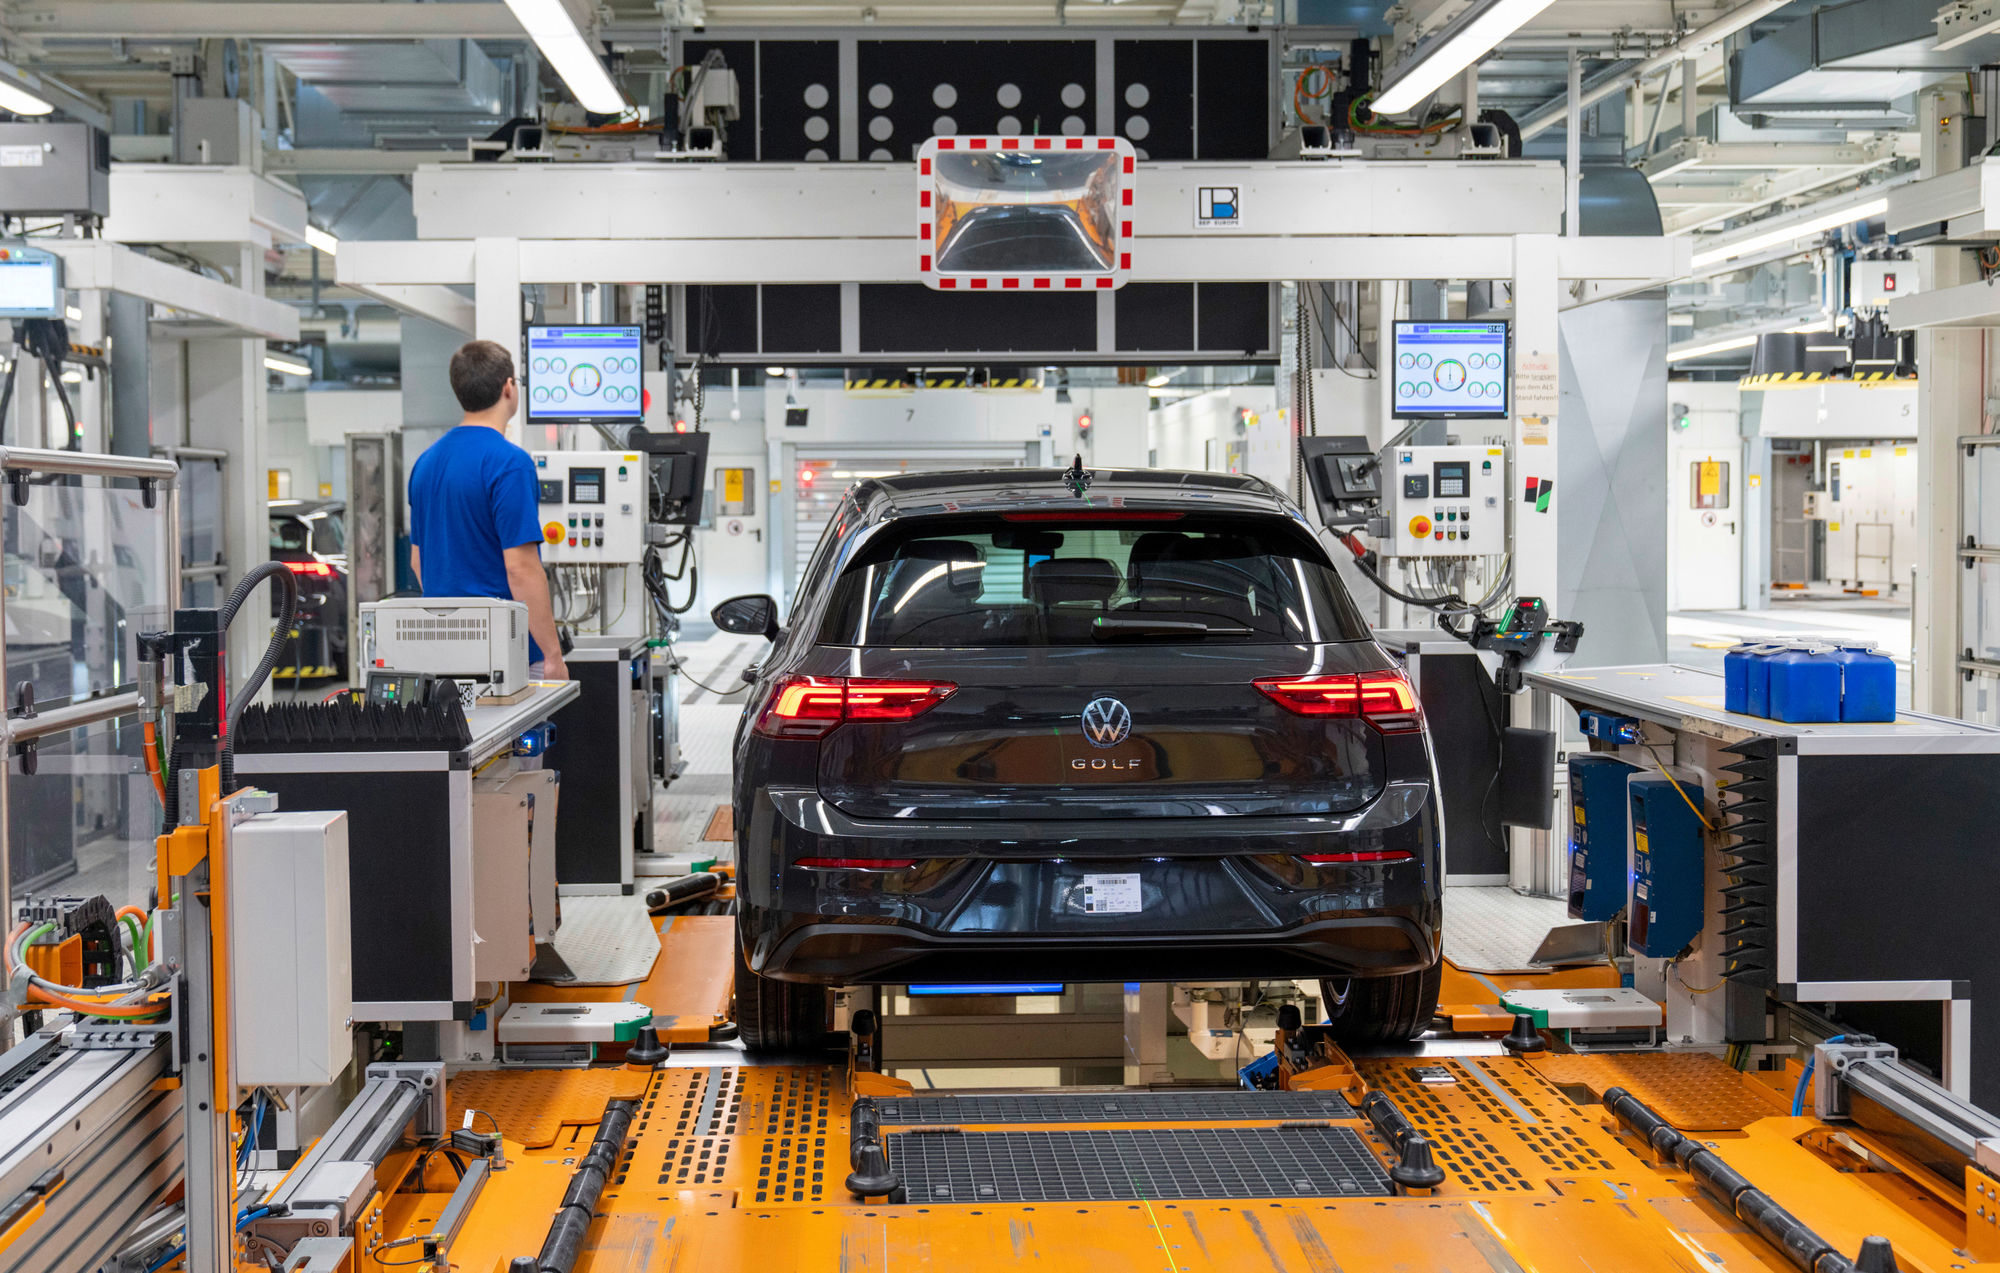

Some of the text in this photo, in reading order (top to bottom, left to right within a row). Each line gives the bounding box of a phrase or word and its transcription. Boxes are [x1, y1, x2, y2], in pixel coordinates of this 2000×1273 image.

[905, 408, 915, 422] 7
[1901, 403, 1911, 417] 5
[1071, 758, 1141, 770] GOLF
